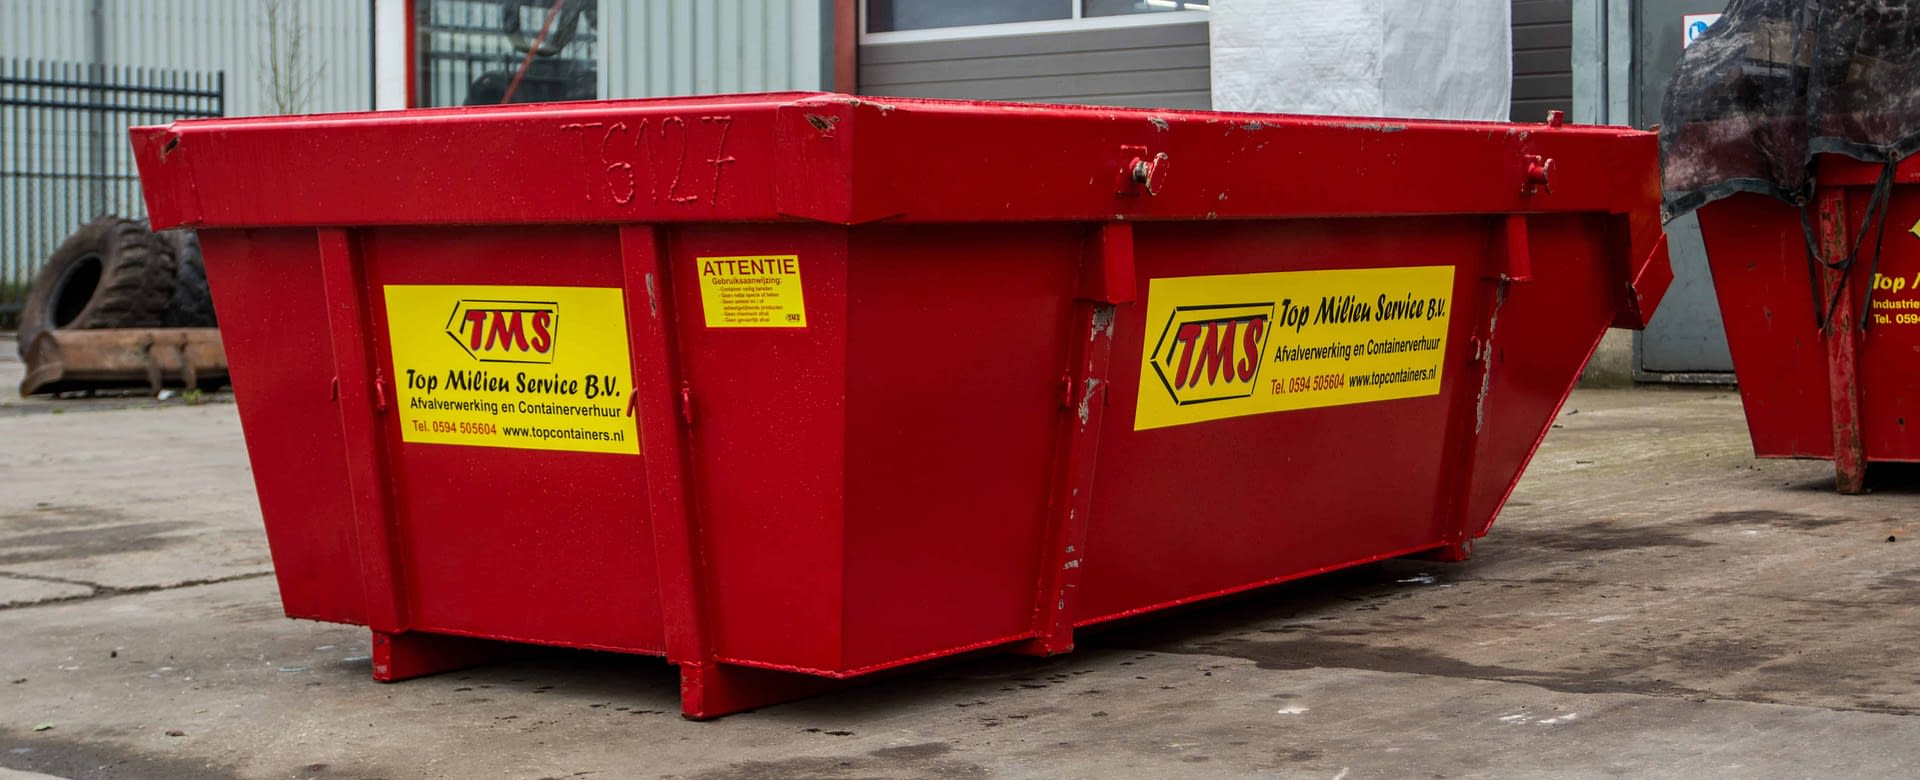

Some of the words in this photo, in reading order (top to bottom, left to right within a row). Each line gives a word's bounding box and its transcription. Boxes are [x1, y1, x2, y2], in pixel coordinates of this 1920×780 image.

[703, 258, 796, 276] ATTENTIE
[711, 277, 783, 286] Gebruiksaanwijzing:
[1873, 272, 1906, 294] Top
[1279, 298, 1310, 334] Top
[1313, 295, 1372, 325] Milieu
[1375, 292, 1424, 322] Service
[1426, 298, 1446, 321] B.V.
[1873, 314, 1892, 324] Tel.
[466, 310, 552, 354] TMS
[1174, 317, 1265, 391] TMS
[1274, 341, 1351, 363] Afvalverwerking
[1353, 345, 1364, 357] en
[1367, 335, 1441, 355] Containerverhuur
[406, 369, 438, 395] Top
[445, 369, 510, 392] Milieu
[516, 372, 578, 395] Service
[584, 374, 621, 399] B.V.
[1271, 378, 1286, 395] Tel.
[1288, 376, 1310, 393] 0594
[1313, 373, 1345, 390] 505604
[1349, 365, 1437, 388] www.topcontainers.nl
[410, 397, 498, 415] Afvalverwerking
[502, 402, 515, 413] en
[518, 400, 621, 418] Containerverhuur
[412, 419, 430, 432] Tel.
[432, 421, 457, 433] 0594
[460, 422, 497, 435] 505604
[502, 426, 625, 442] www.topcontainers.nl
